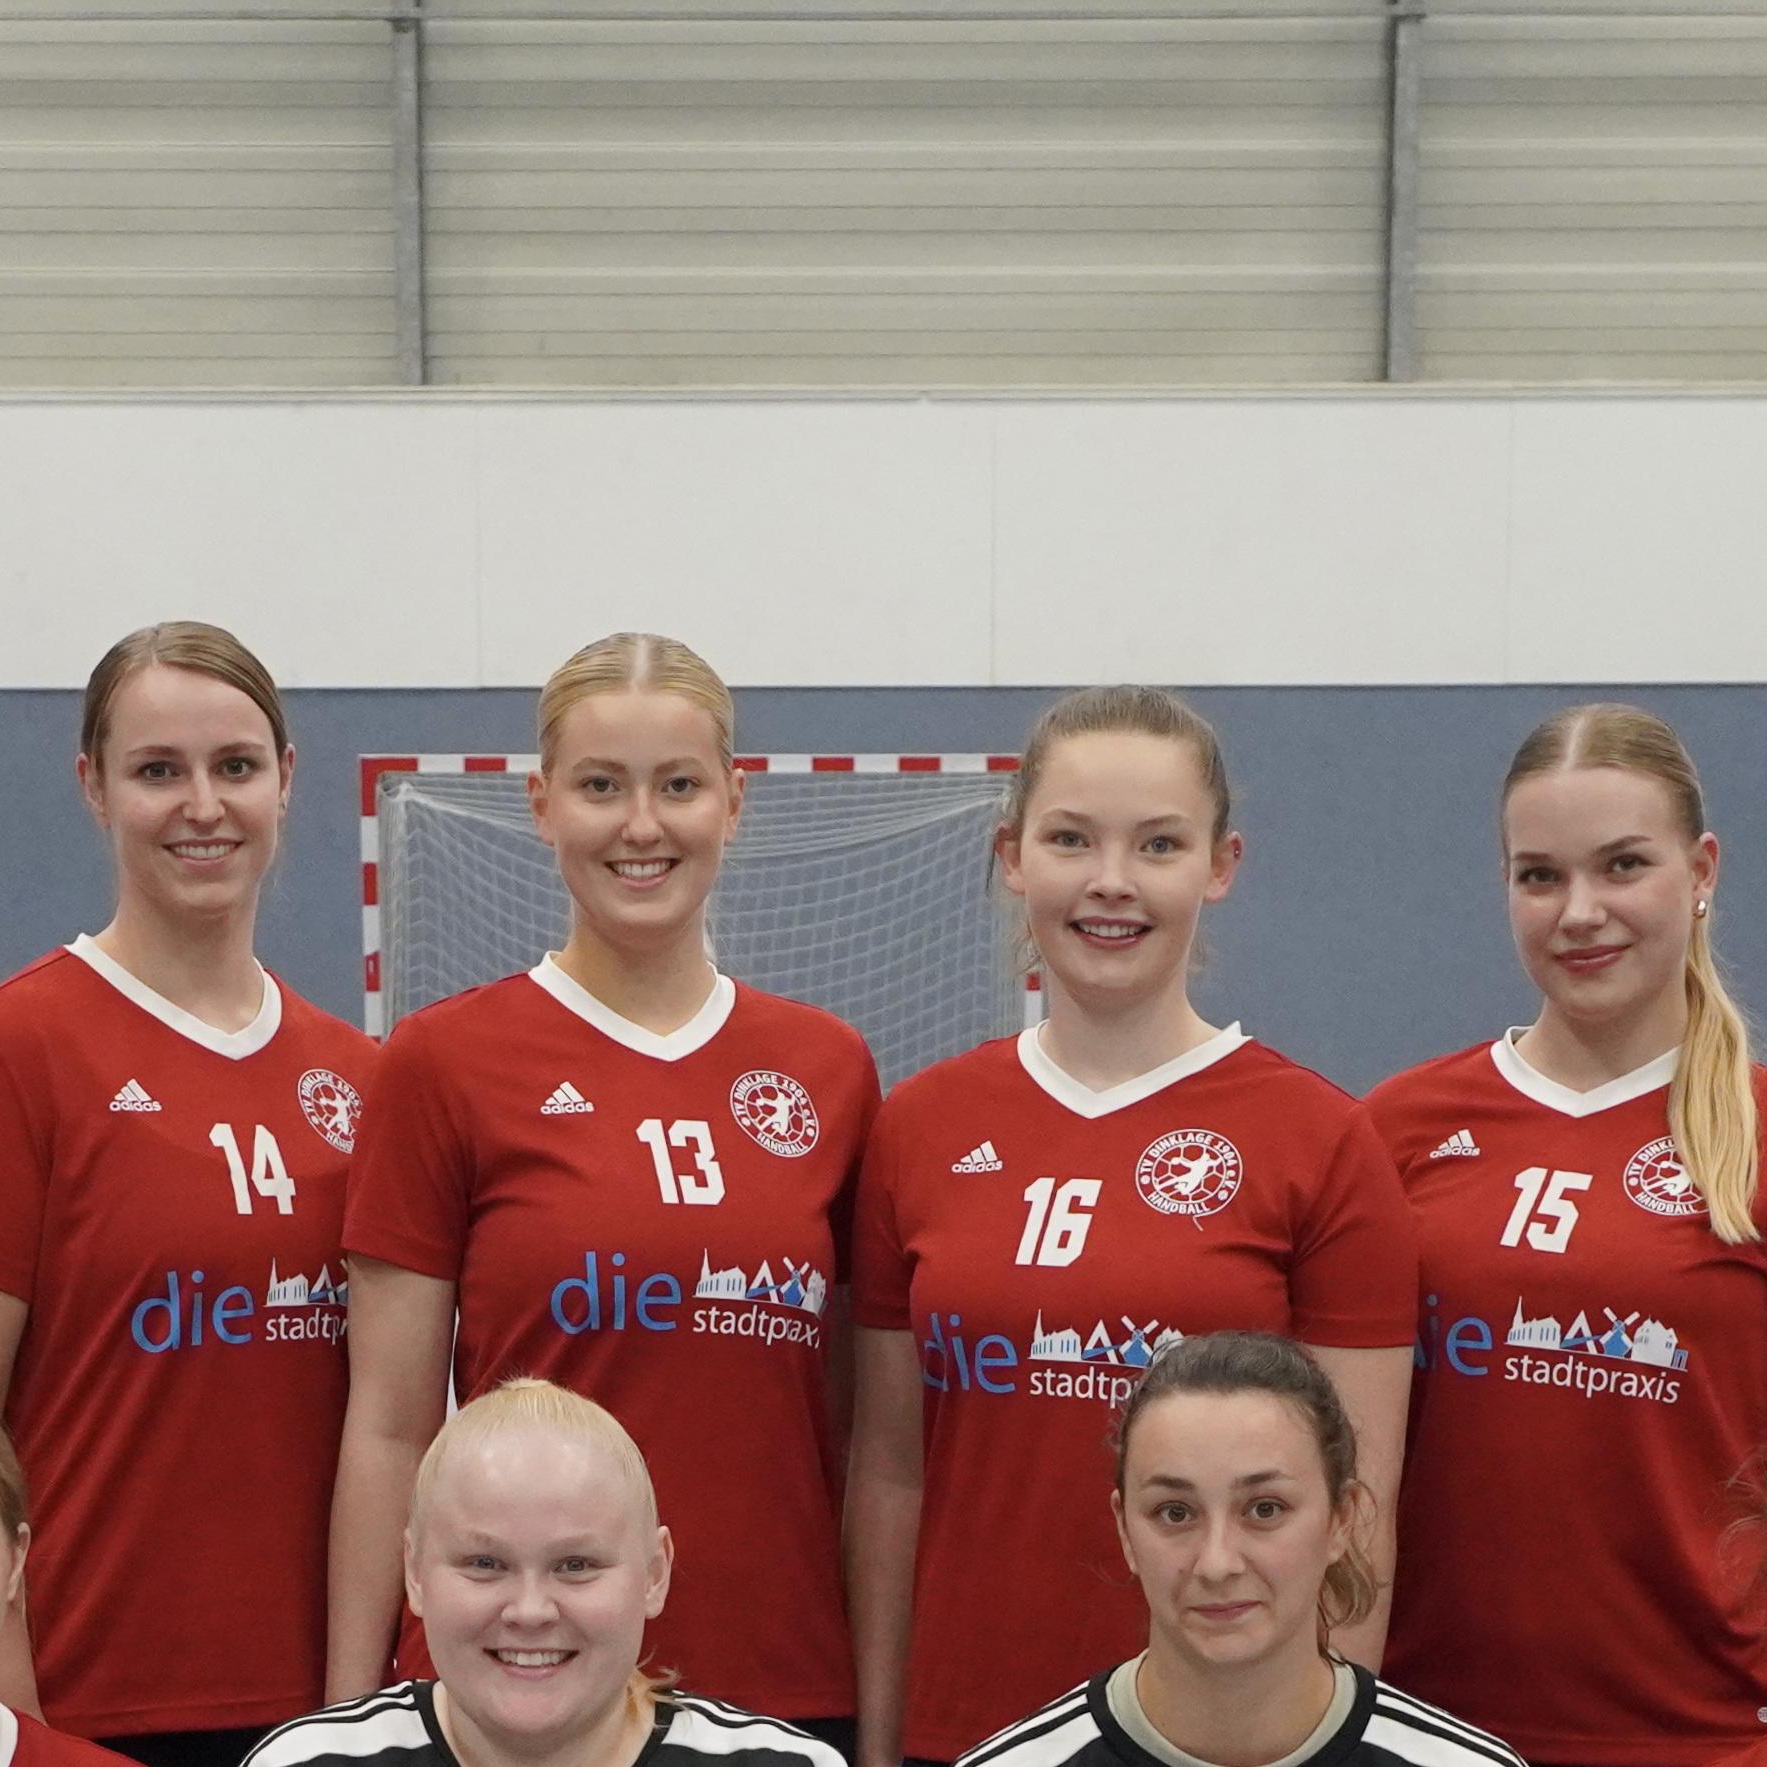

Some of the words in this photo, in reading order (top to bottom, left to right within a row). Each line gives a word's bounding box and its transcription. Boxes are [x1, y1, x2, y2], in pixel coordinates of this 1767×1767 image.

[110, 1100, 162, 1112] adidas
[734, 1074, 778, 1100] DINKLAGE
[302, 1101, 313, 1112] TV
[541, 1102, 594, 1115] adidas
[733, 1102, 746, 1116] TV
[636, 1119, 725, 1205] 13
[756, 1132, 808, 1155] HANDBALL
[1139, 1158, 1154, 1173] TV
[1149, 1132, 1214, 1158] DINKLAGE
[1628, 1162, 1642, 1176] TV
[1638, 1138, 1674, 1162] DINKL
[209, 1124, 295, 1214] 14
[952, 1160, 1002, 1174] adidas
[1016, 1178, 1102, 1266] 16
[1147, 1191, 1212, 1215] HANDBALL
[1501, 1167, 1592, 1253] 15
[1635, 1192, 1697, 1215] HANDBALL
[131, 1270, 254, 1353] die
[550, 1251, 682, 1334] die
[693, 1305, 820, 1349] stadtprax
[1030, 1366, 1143, 1409] stadtp
[1504, 1356, 1681, 1403] stadtpraxis
